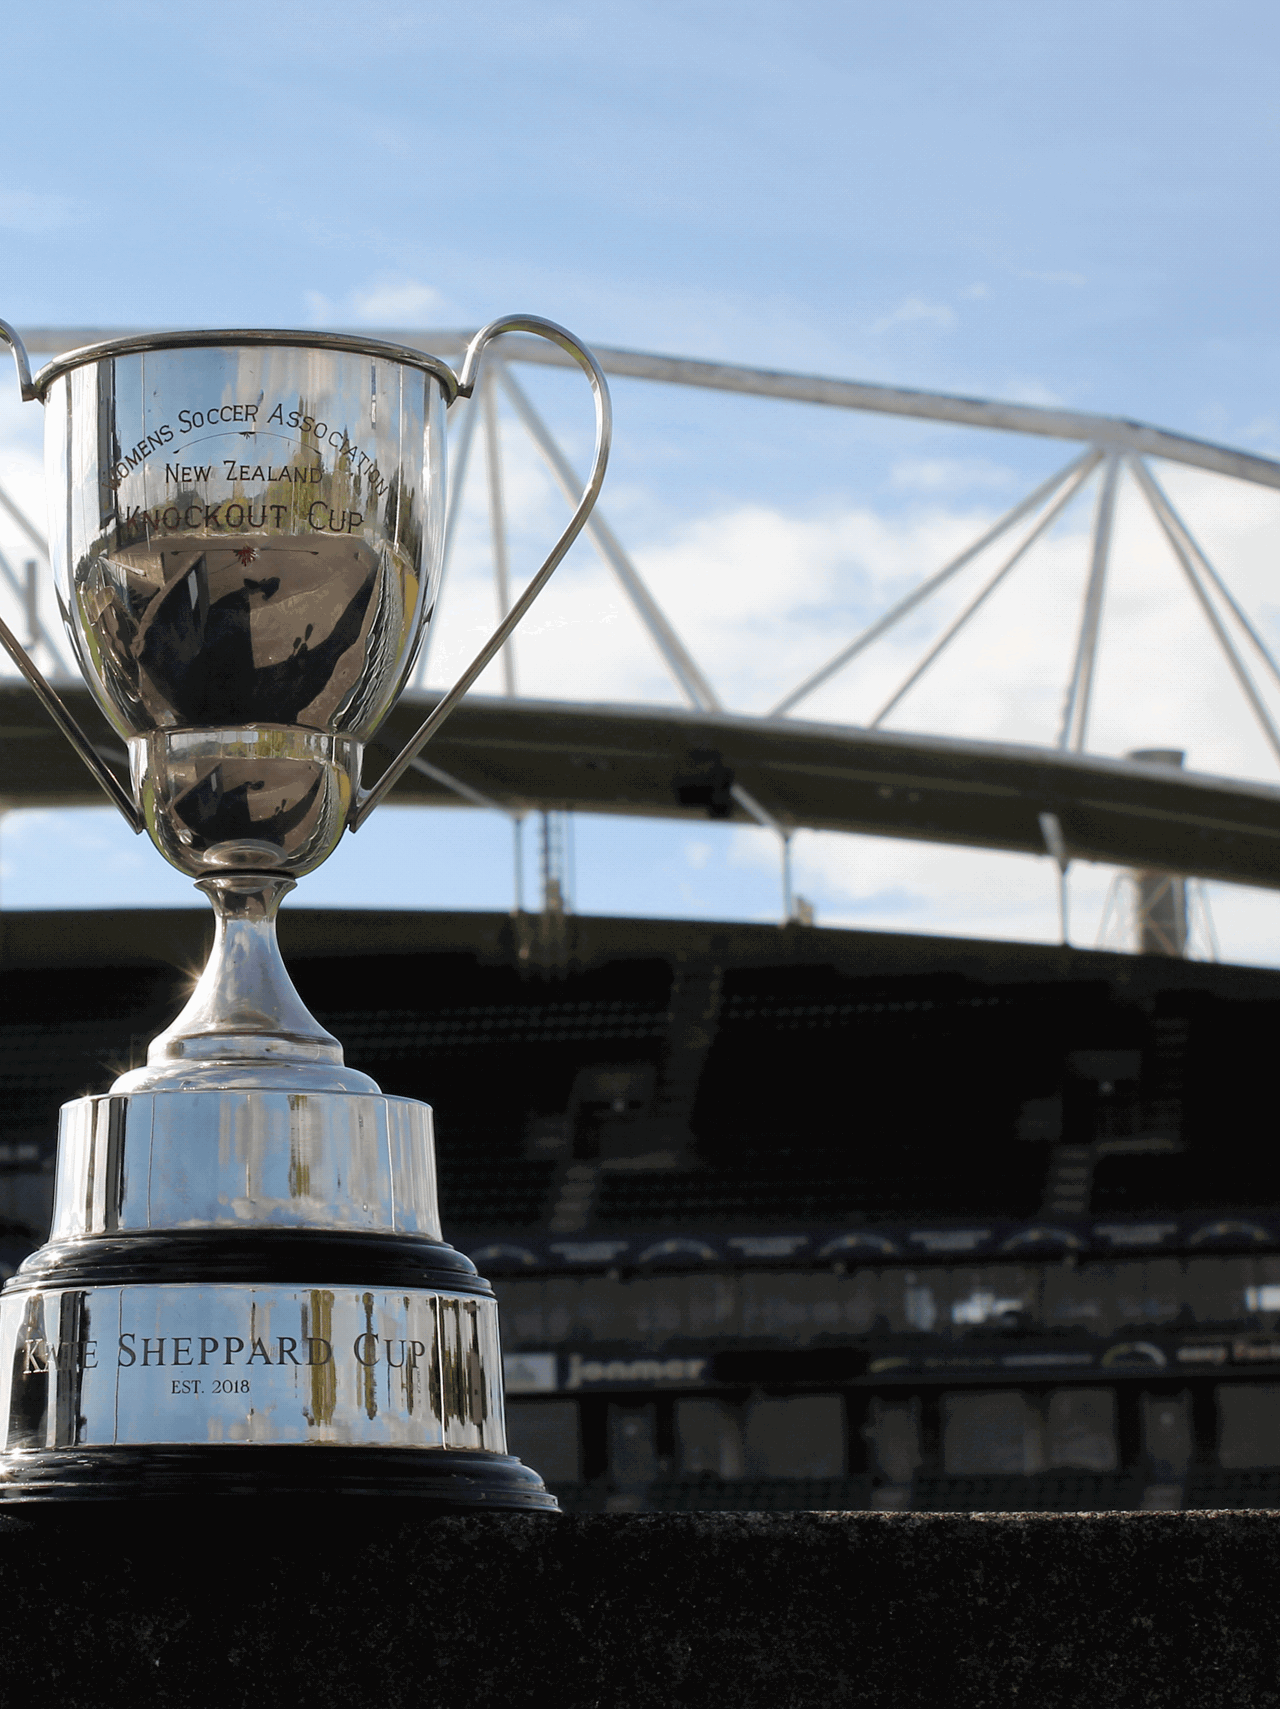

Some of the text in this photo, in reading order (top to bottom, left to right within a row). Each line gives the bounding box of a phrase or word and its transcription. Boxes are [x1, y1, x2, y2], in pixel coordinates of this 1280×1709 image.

[101, 403, 389, 496] WOMENS SOCCER ASSOCIATION
[165, 460, 324, 484] NEW ZEALAND
[126, 501, 365, 534] KNOCKOUT CUP
[117, 1332, 333, 1368] SHEPPARD
[353, 1332, 426, 1369] CUP
[171, 1379, 251, 1395] EST. 2018
